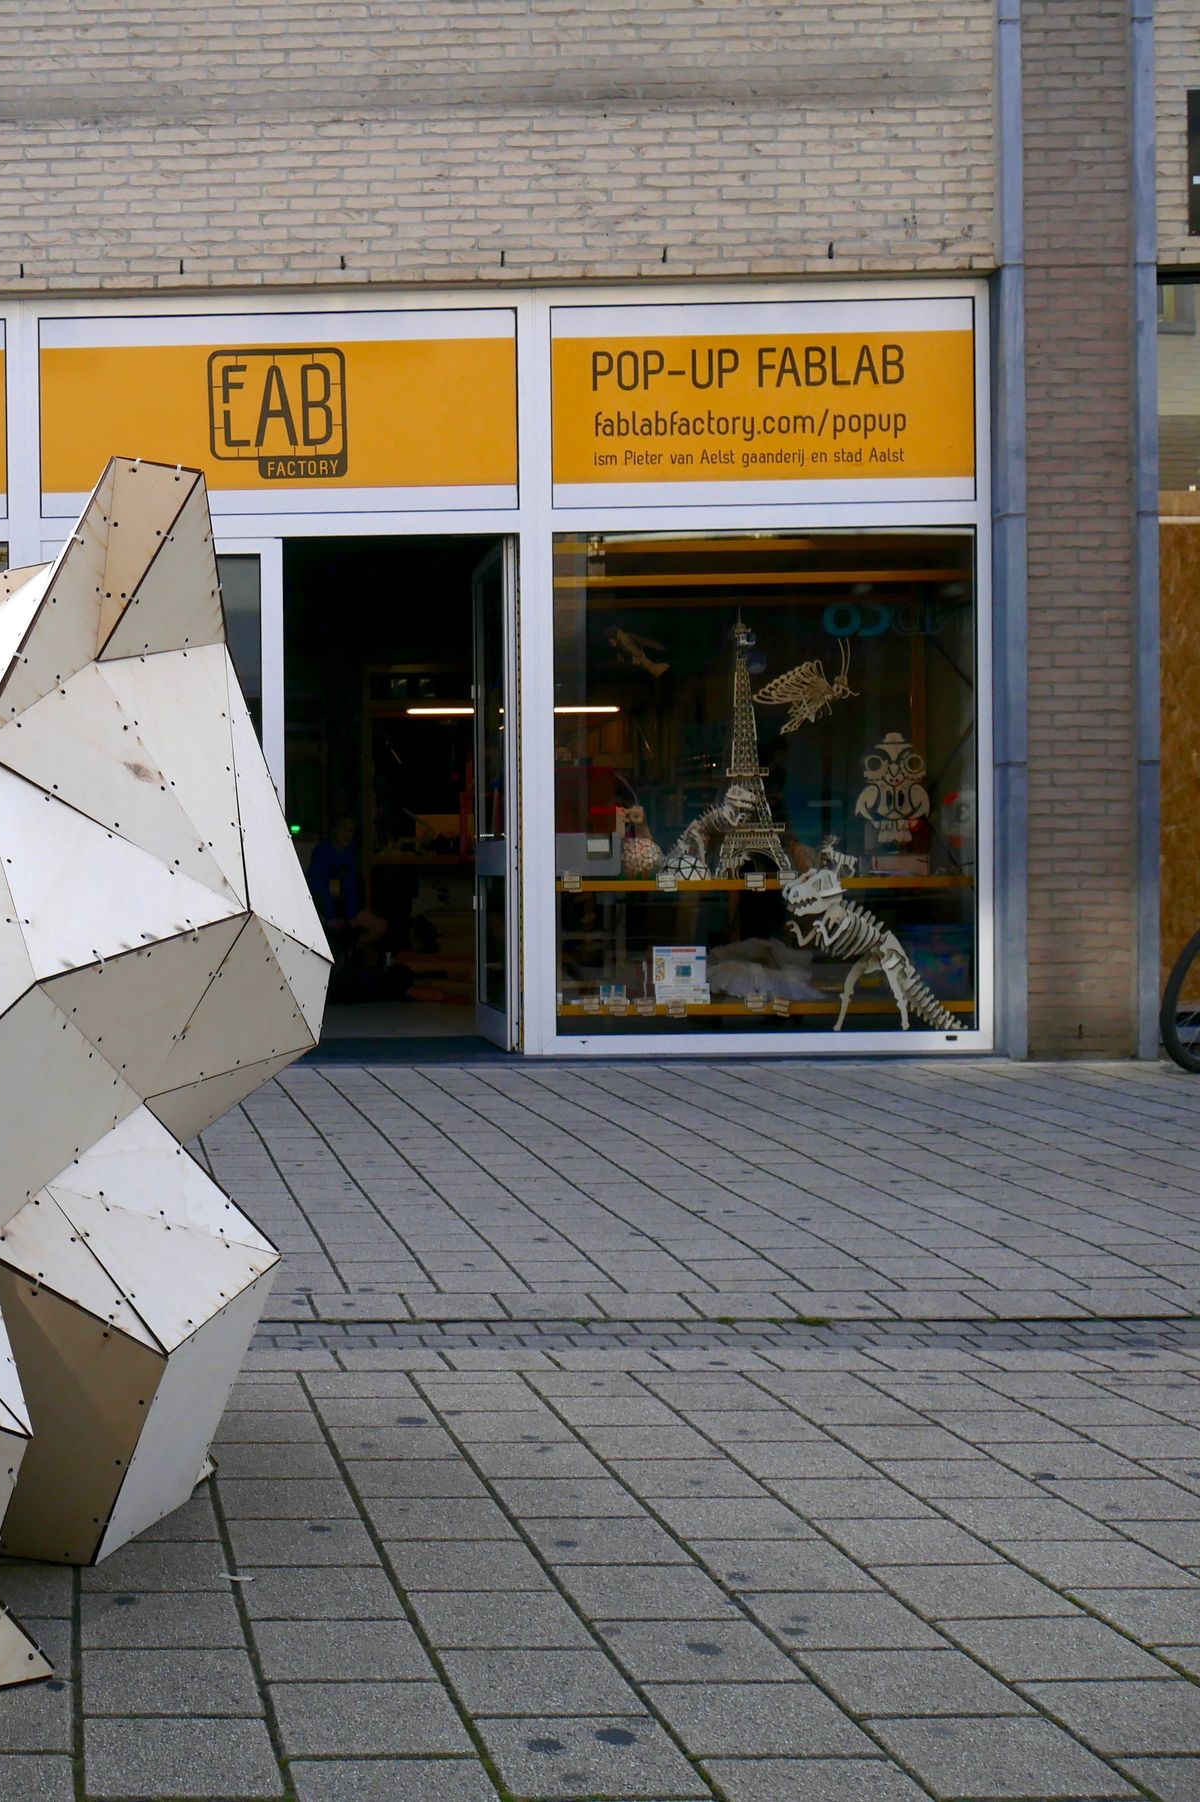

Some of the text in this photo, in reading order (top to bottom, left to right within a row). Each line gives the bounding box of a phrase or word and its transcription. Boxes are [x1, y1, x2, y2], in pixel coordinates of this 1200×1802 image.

[592, 344, 905, 391] POP-UP FABLAB
[594, 408, 908, 442] fablabfactory.com/popup
[266, 459, 339, 477] FACTORY
[593, 446, 906, 468] ism Pieter van Aelst gaanderij en stad Aalst
